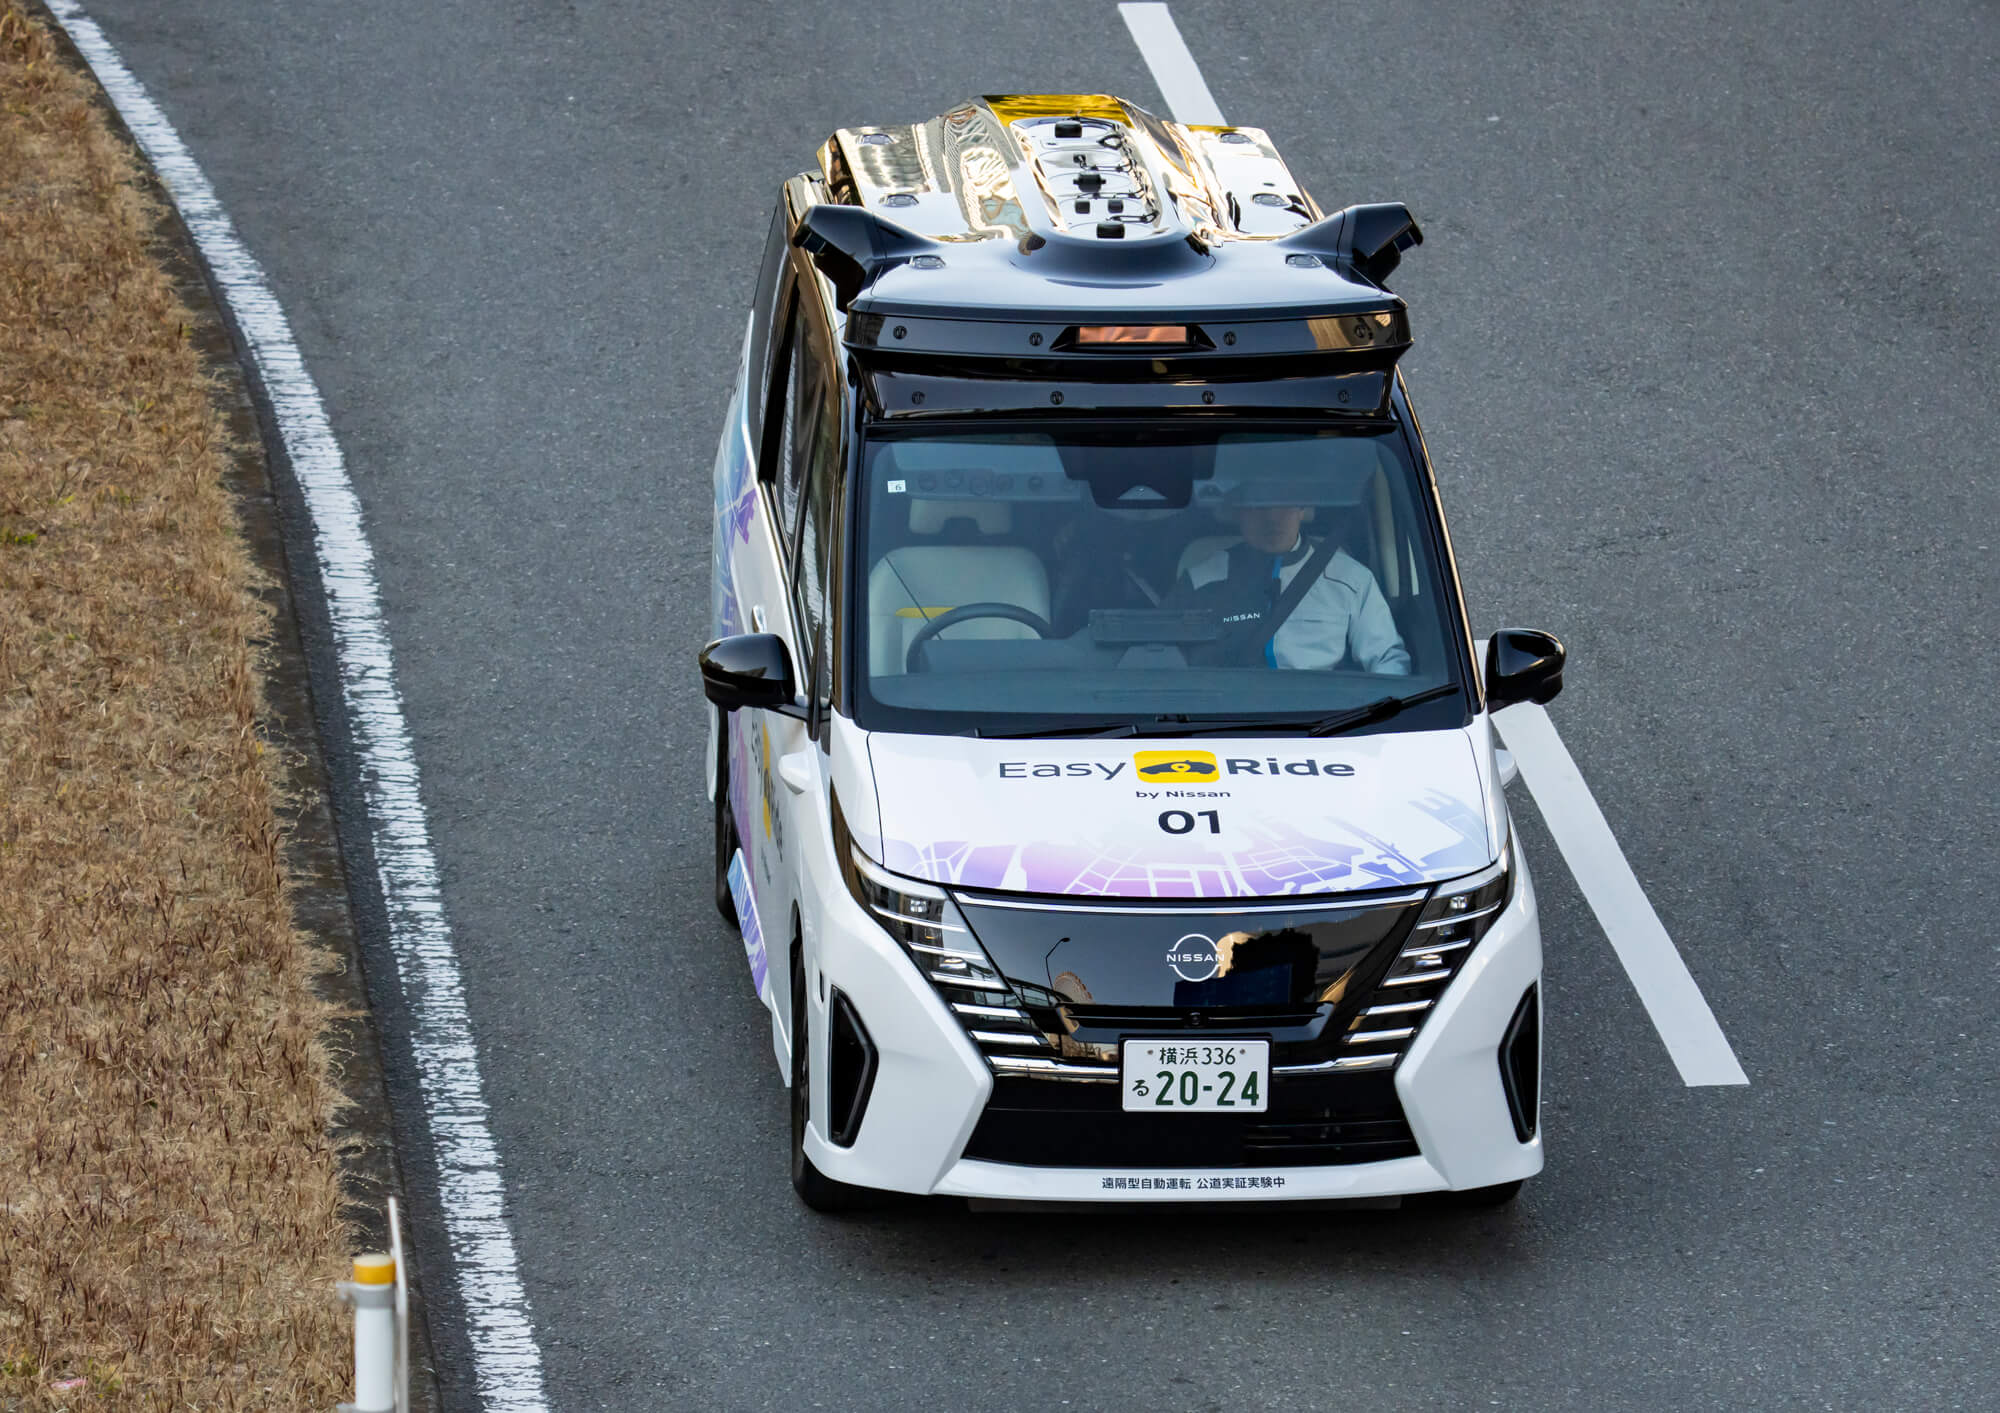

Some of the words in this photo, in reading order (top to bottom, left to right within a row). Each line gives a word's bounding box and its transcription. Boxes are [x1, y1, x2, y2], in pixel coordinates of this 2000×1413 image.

[1223, 612, 1260, 623] NISSAN
[999, 762, 1127, 781] Easy
[1225, 757, 1356, 777] Ride
[1135, 791, 1159, 799] by
[1165, 790, 1231, 798] Nissan
[1158, 810, 1221, 834] 01
[1166, 953, 1225, 962] NISSAN
[1155, 1070, 1260, 1107] 20-24
[1102, 1176, 1191, 1190] 遠隔型自動運転
[1197, 1176, 1286, 1190] 公道実証実験中
